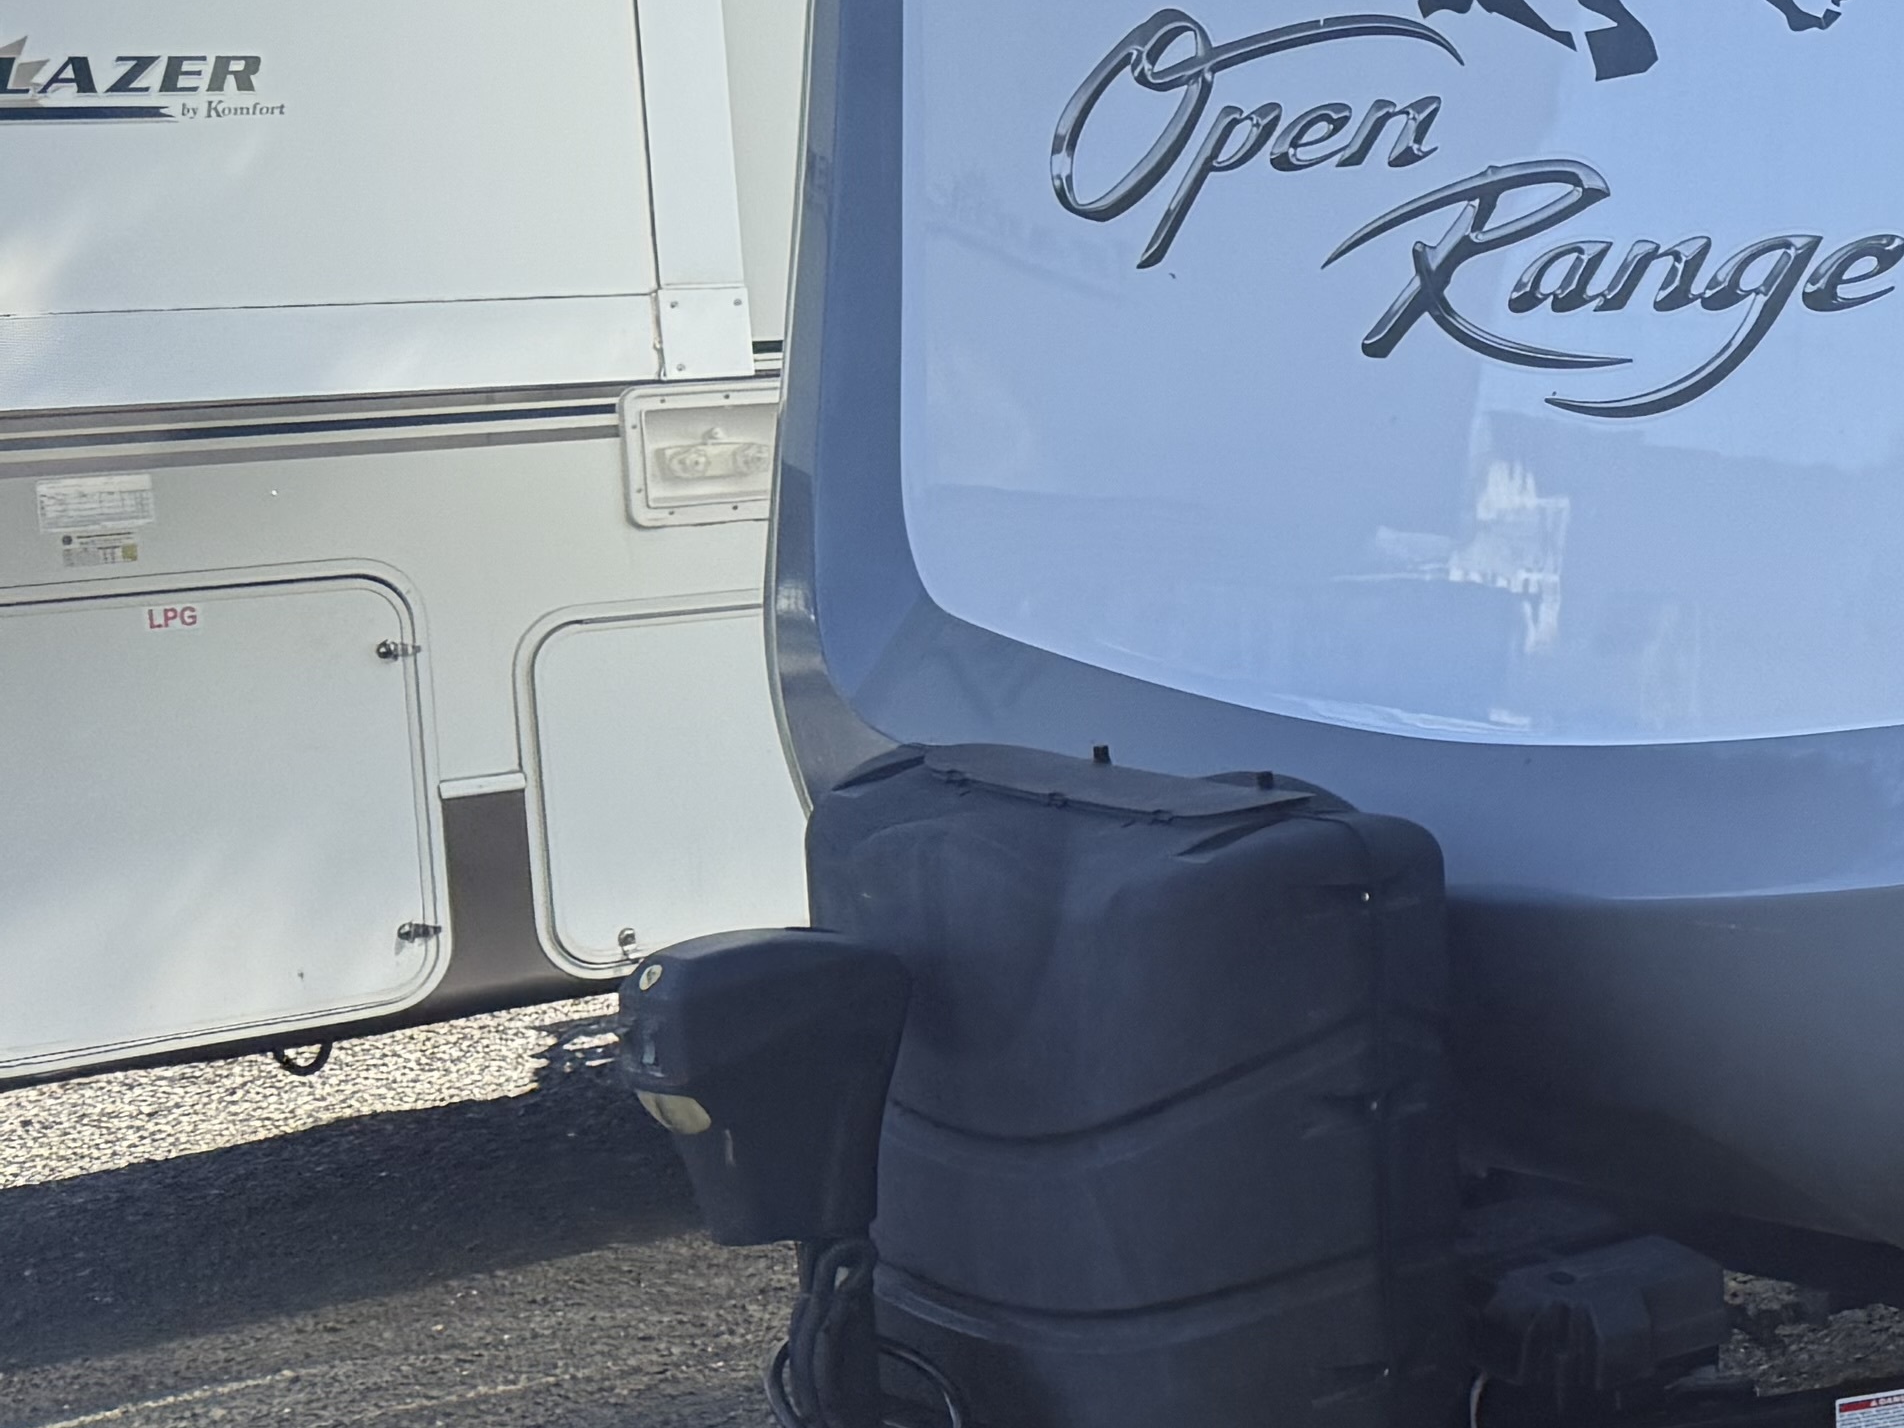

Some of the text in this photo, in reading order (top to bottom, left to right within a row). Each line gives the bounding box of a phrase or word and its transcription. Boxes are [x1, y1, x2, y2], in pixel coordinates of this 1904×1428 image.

[181, 100, 286, 119] by Komfort
[1050, 9, 1465, 269] Open
[147, 606, 197, 629] LPG
